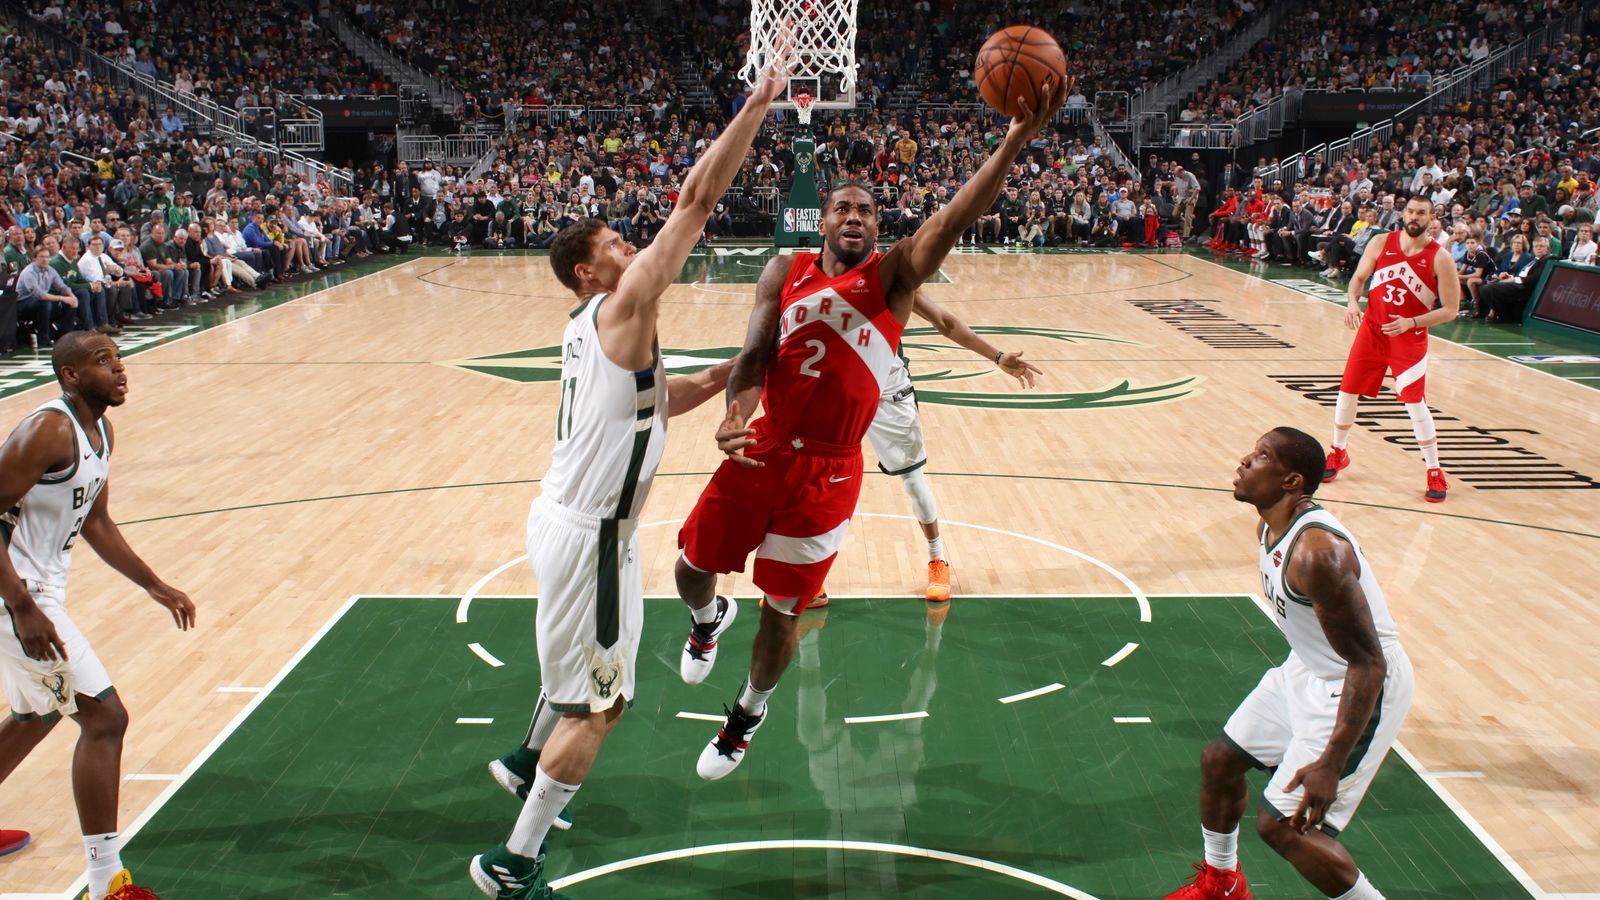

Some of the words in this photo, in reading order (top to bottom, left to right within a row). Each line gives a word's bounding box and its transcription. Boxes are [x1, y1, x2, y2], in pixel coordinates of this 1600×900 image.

[796, 209, 820, 220] EASTER
[796, 221, 819, 232] FINALS
[1380, 267, 1422, 292] NORTH
[1382, 284, 1407, 306] 33
[781, 298, 871, 347] NORTH
[800, 339, 826, 378] 2
[557, 377, 577, 441] 11
